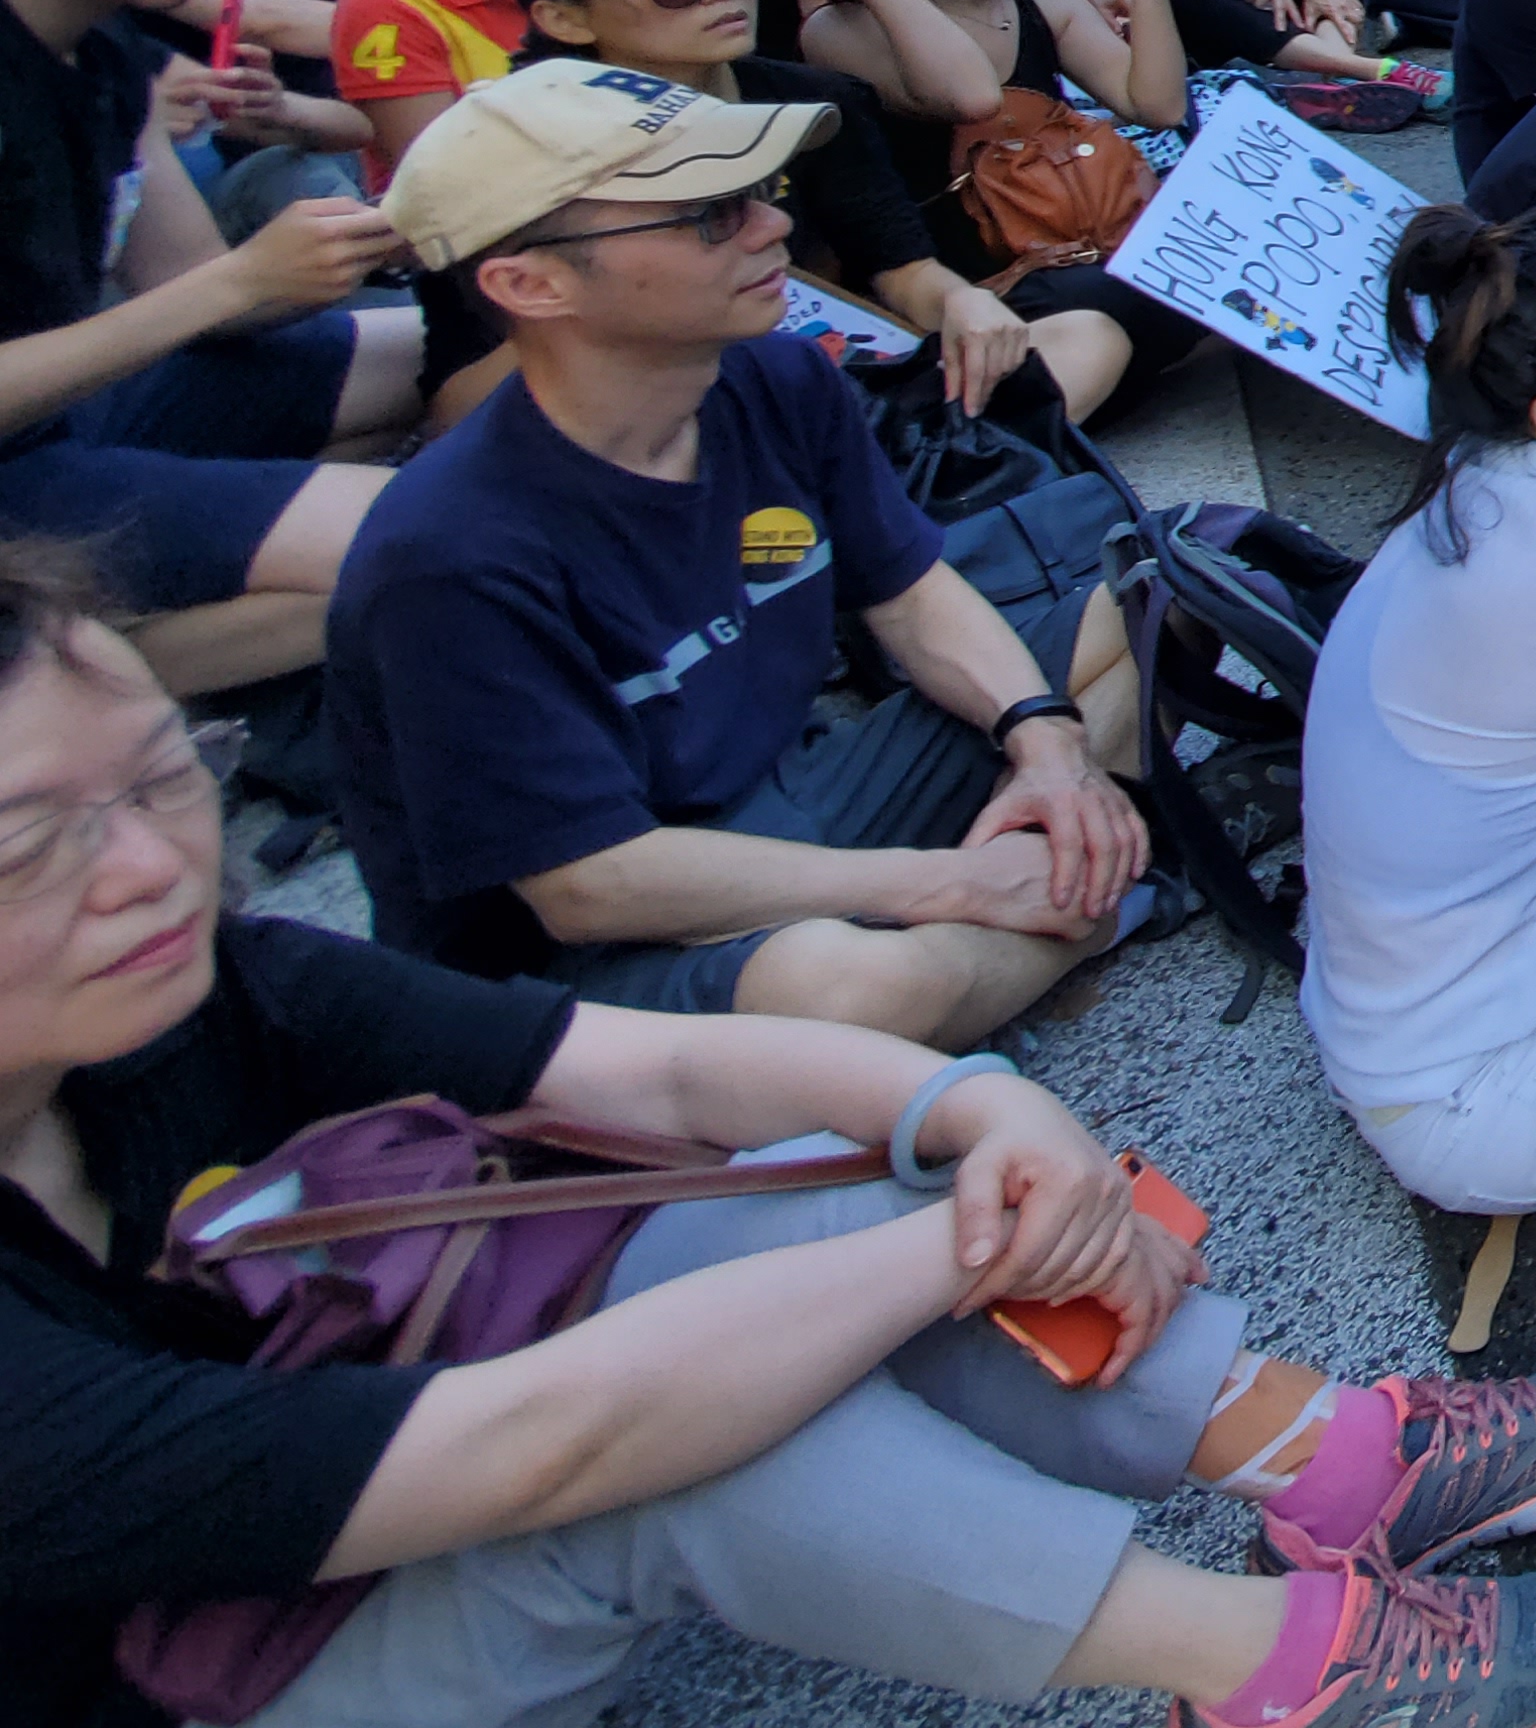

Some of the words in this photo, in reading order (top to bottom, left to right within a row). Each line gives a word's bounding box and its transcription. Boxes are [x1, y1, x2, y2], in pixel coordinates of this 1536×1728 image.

[351, 23, 406, 80] 4
[1133, 199, 1248, 315] HONG
[1212, 120, 1310, 202] KONG
